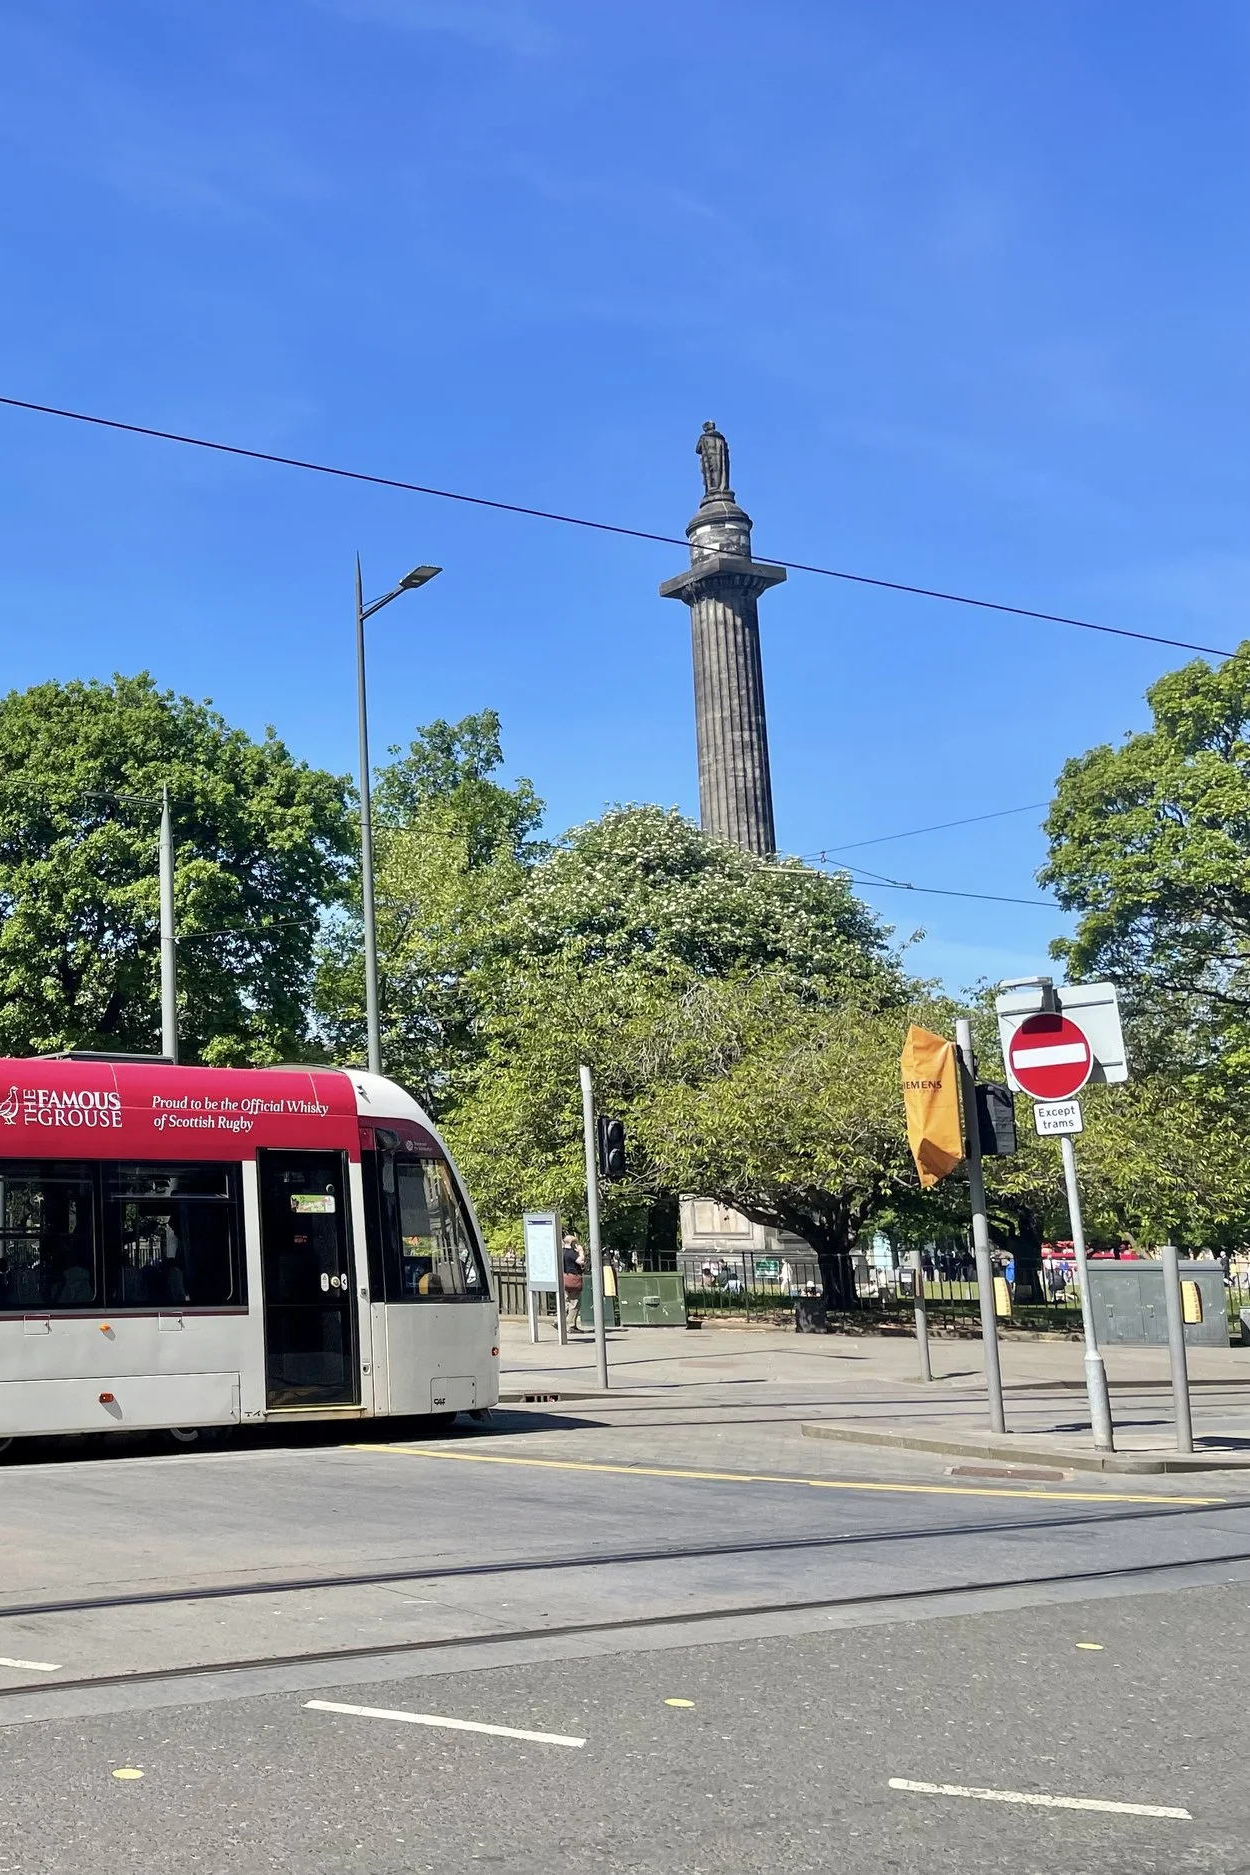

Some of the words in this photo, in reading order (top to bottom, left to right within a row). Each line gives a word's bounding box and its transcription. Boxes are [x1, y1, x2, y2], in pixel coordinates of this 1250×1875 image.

[903, 1080, 942, 1089] IEMENS
[23, 1089, 37, 1125] THE
[37, 1089, 121, 1111] FAMOUS
[152, 1096, 188, 1110] Proud
[190, 1098, 202, 1110] to
[205, 1097, 218, 1111] be
[220, 1098, 238, 1111] the
[241, 1098, 283, 1114] Official
[286, 1100, 328, 1116] Whisky
[37, 1108, 122, 1128] GROUSE
[1039, 1106, 1076, 1117] Except
[154, 1114, 167, 1130] of
[168, 1114, 215, 1129] Scottish
[218, 1116, 254, 1132] Rugby
[1043, 1119, 1074, 1129] trams
